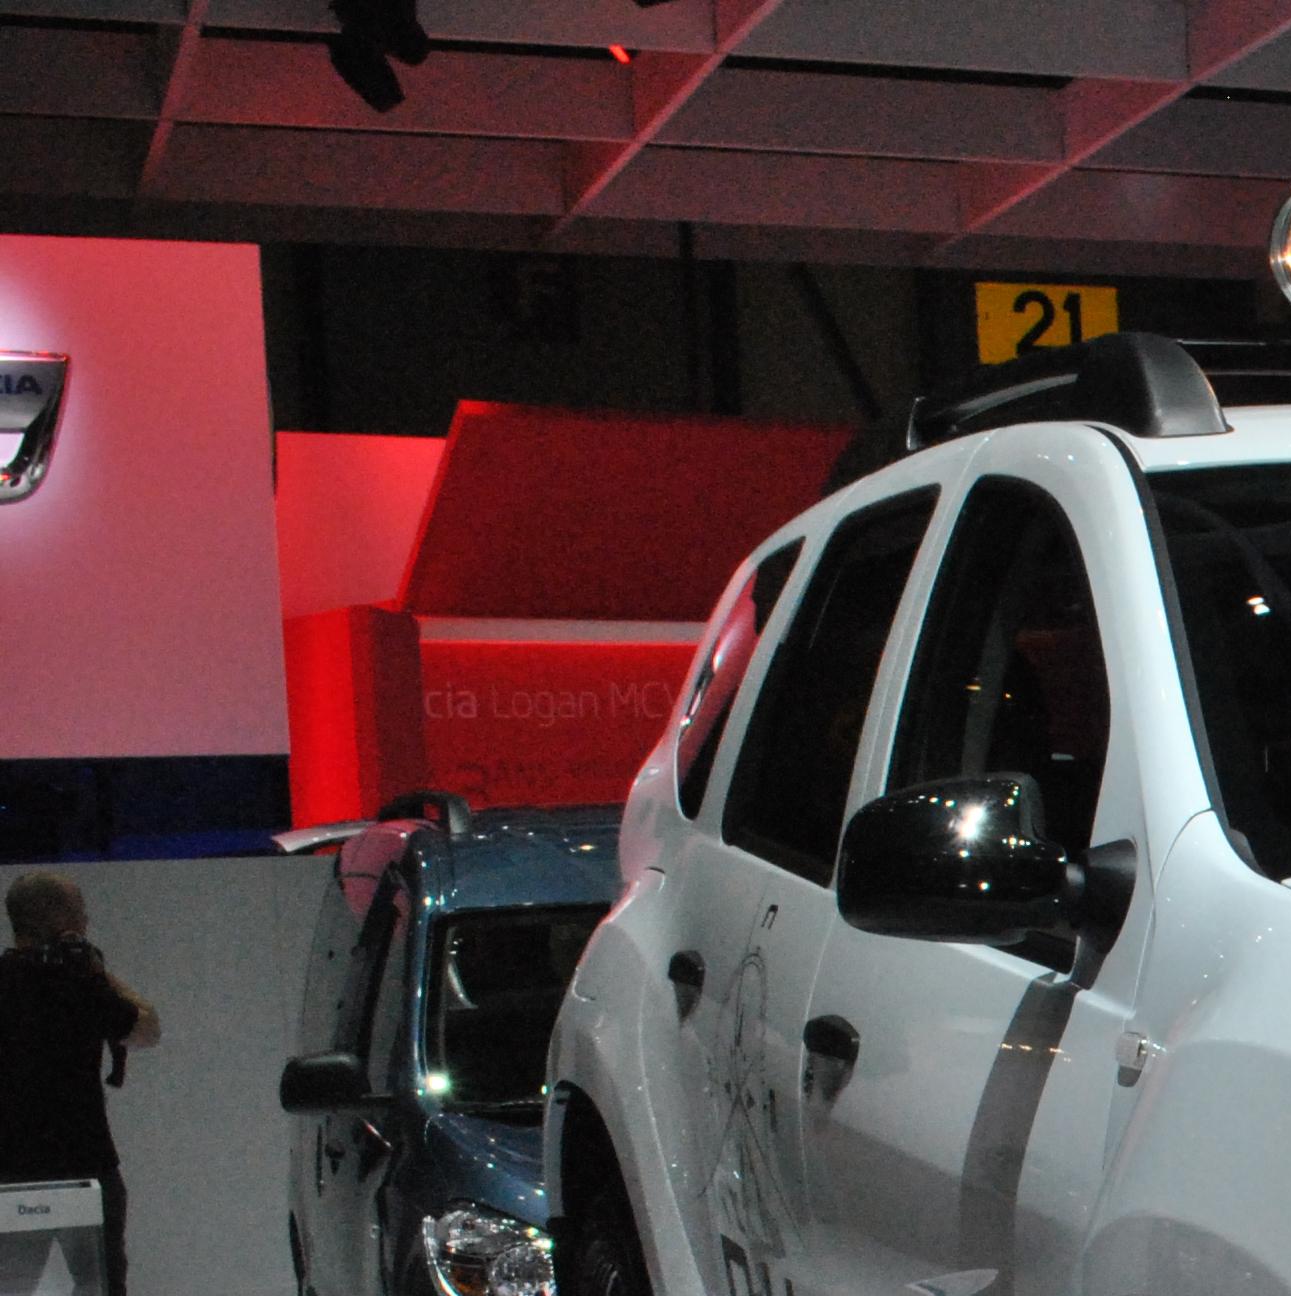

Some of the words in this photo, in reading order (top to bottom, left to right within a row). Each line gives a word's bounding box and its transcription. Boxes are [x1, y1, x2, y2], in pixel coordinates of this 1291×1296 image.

[1013, 290, 1082, 355] 21
[0, 374, 42, 395] IA
[493, 685, 600, 727] Logan
